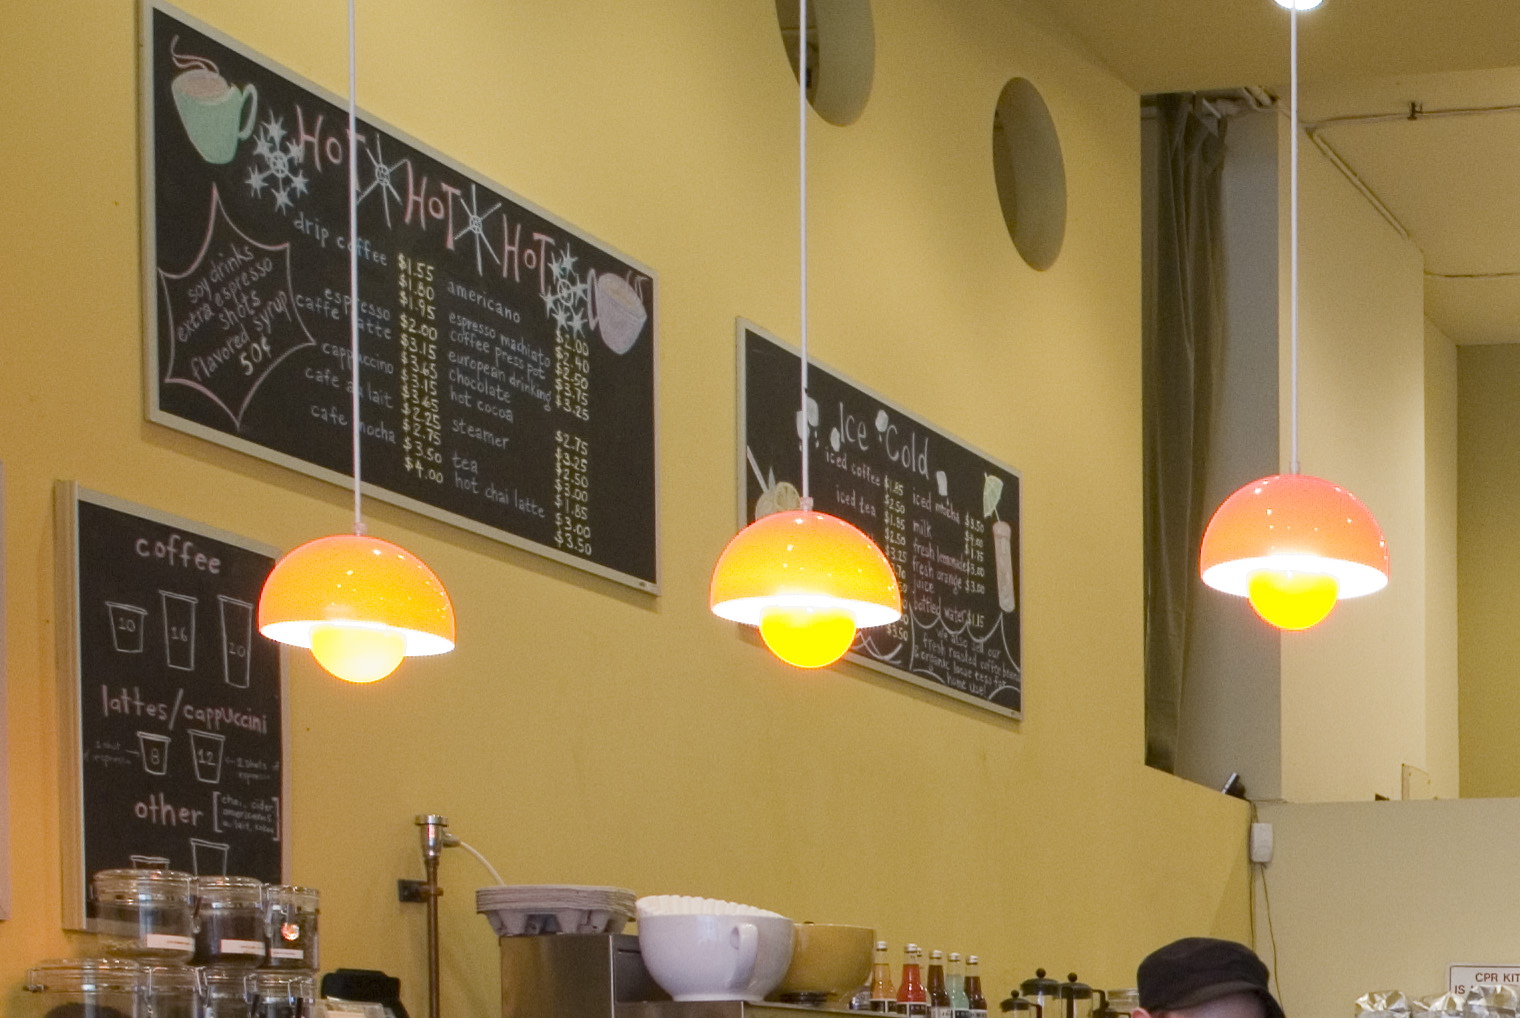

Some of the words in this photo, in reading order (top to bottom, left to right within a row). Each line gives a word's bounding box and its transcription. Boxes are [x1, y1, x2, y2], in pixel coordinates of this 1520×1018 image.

[294, 211, 329, 248] drip
[188, 278, 211, 303] soy
[210, 243, 254, 282] drinks
[399, 253, 434, 281] $1.55
[178, 303, 213, 342] extra
[215, 258, 273, 307] espresso
[325, 288, 390, 321] espesso
[400, 291, 436, 320] $1.95
[448, 281, 520, 323] americano
[191, 323, 249, 380] flavored
[254, 291, 292, 334] syrup
[401, 313, 438, 340] $2.00
[450, 312, 496, 338] espresso
[401, 333, 437, 359] $3.15
[450, 331, 489, 352] coffee
[495, 347, 524, 368] press
[527, 364, 545, 381] pot
[401, 351, 437, 379] $3.65
[305, 367, 339, 388] cafe
[367, 382, 393, 409] lait
[401, 368, 437, 395] $3.15
[449, 351, 505, 382] european
[510, 373, 551, 412] drinking
[449, 368, 510, 403] chocolate
[310, 405, 347, 425] cafe
[402, 403, 441, 430] $2.25
[450, 385, 471, 407] hot
[477, 401, 513, 423] cocoa
[403, 419, 441, 445] $2.75
[452, 418, 509, 449] steamer
[555, 430, 588, 455] $2.75
[840, 402, 868, 451] Ice
[886, 424, 929, 480] Cold
[403, 436, 442, 463] $3.50
[452, 451, 478, 473] tea
[405, 457, 443, 483] $4.00
[825, 446, 847, 471] iced
[852, 464, 880, 486] coffee
[455, 470, 479, 494] hot
[485, 482, 509, 504] chai
[515, 489, 545, 518] latte
[836, 485, 856, 508] iced
[860, 497, 876, 517] tea
[913, 487, 931, 512] iced
[555, 513, 591, 538] $3.00
[913, 520, 932, 538] milk
[136, 535, 221, 574] coffee
[555, 530, 591, 555] $3.50
[913, 556, 934, 578] fresh
[937, 571, 961, 595] orange
[944, 605, 967, 623] water
[118, 618, 136, 632] 10
[171, 626, 188, 642] 16
[198, 749, 216, 765] 12
[135, 793, 204, 826] other
[1475, 973, 1498, 983] CPR
[1503, 973, 1520, 982] KIT
